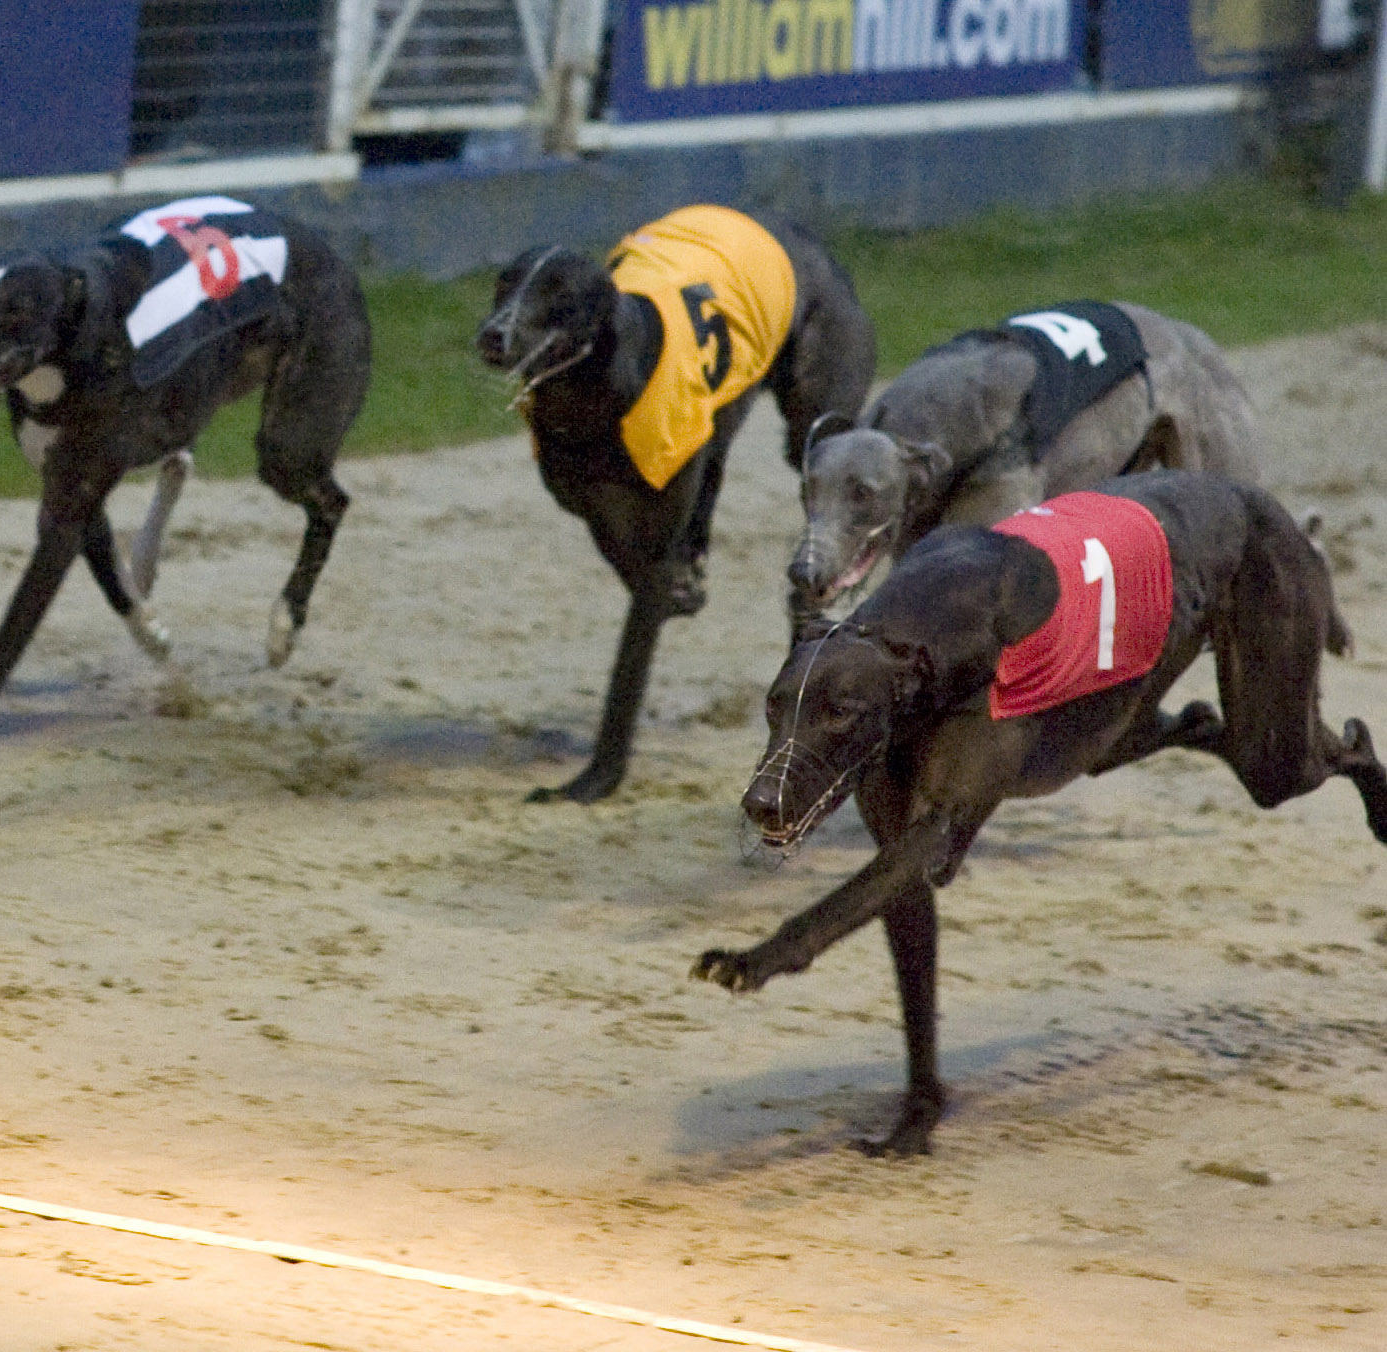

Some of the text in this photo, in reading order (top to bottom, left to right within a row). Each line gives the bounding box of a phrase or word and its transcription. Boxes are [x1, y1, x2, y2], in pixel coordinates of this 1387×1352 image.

[156, 216, 241, 300] 6
[679, 282, 733, 394] 5
[1008, 310, 1108, 367] 4
[1080, 537, 1117, 670] 1
